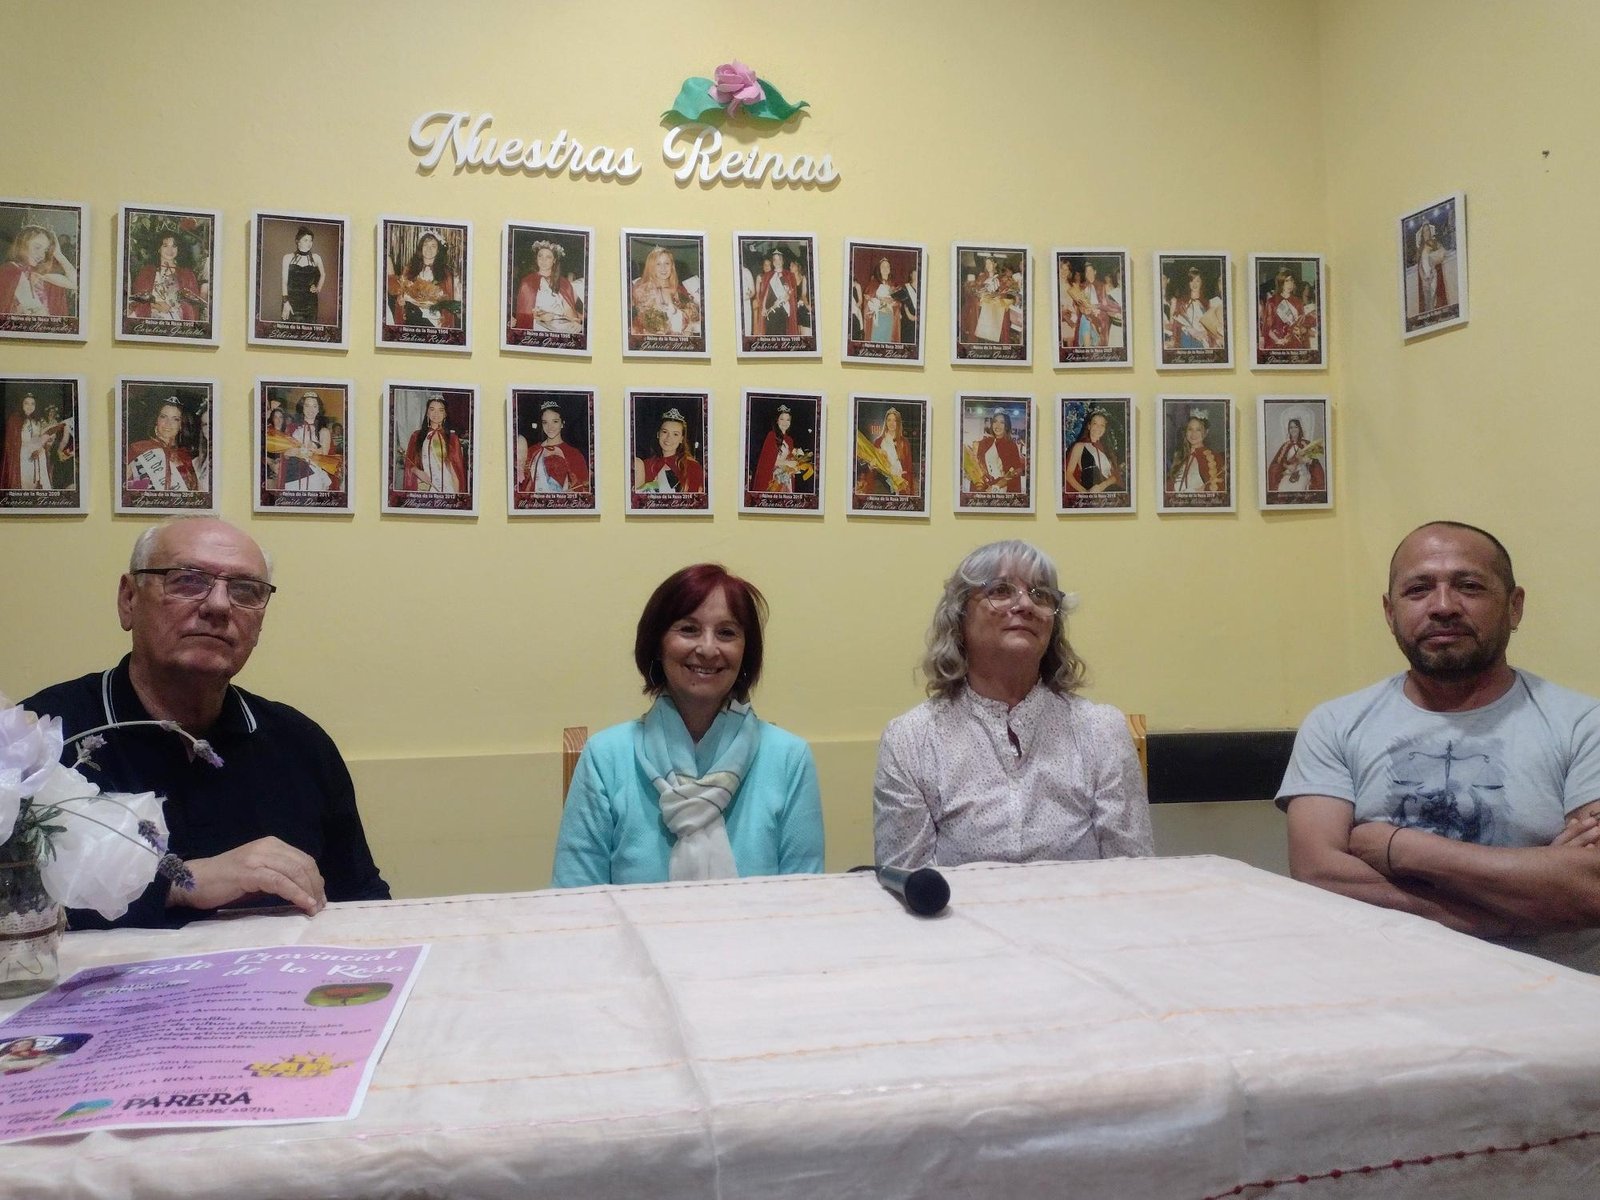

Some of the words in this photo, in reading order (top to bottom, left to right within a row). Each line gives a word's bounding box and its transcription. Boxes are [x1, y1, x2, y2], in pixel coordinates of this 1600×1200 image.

[410, 111, 642, 177] Nuestras
[664, 123, 841, 184] Reinas
[232, 950, 398, 964] Provincial
[221, 964, 262, 977] de
[280, 962, 312, 974] la
[326, 964, 404, 980] Rosa
[122, 1091, 253, 1110] PARERA
